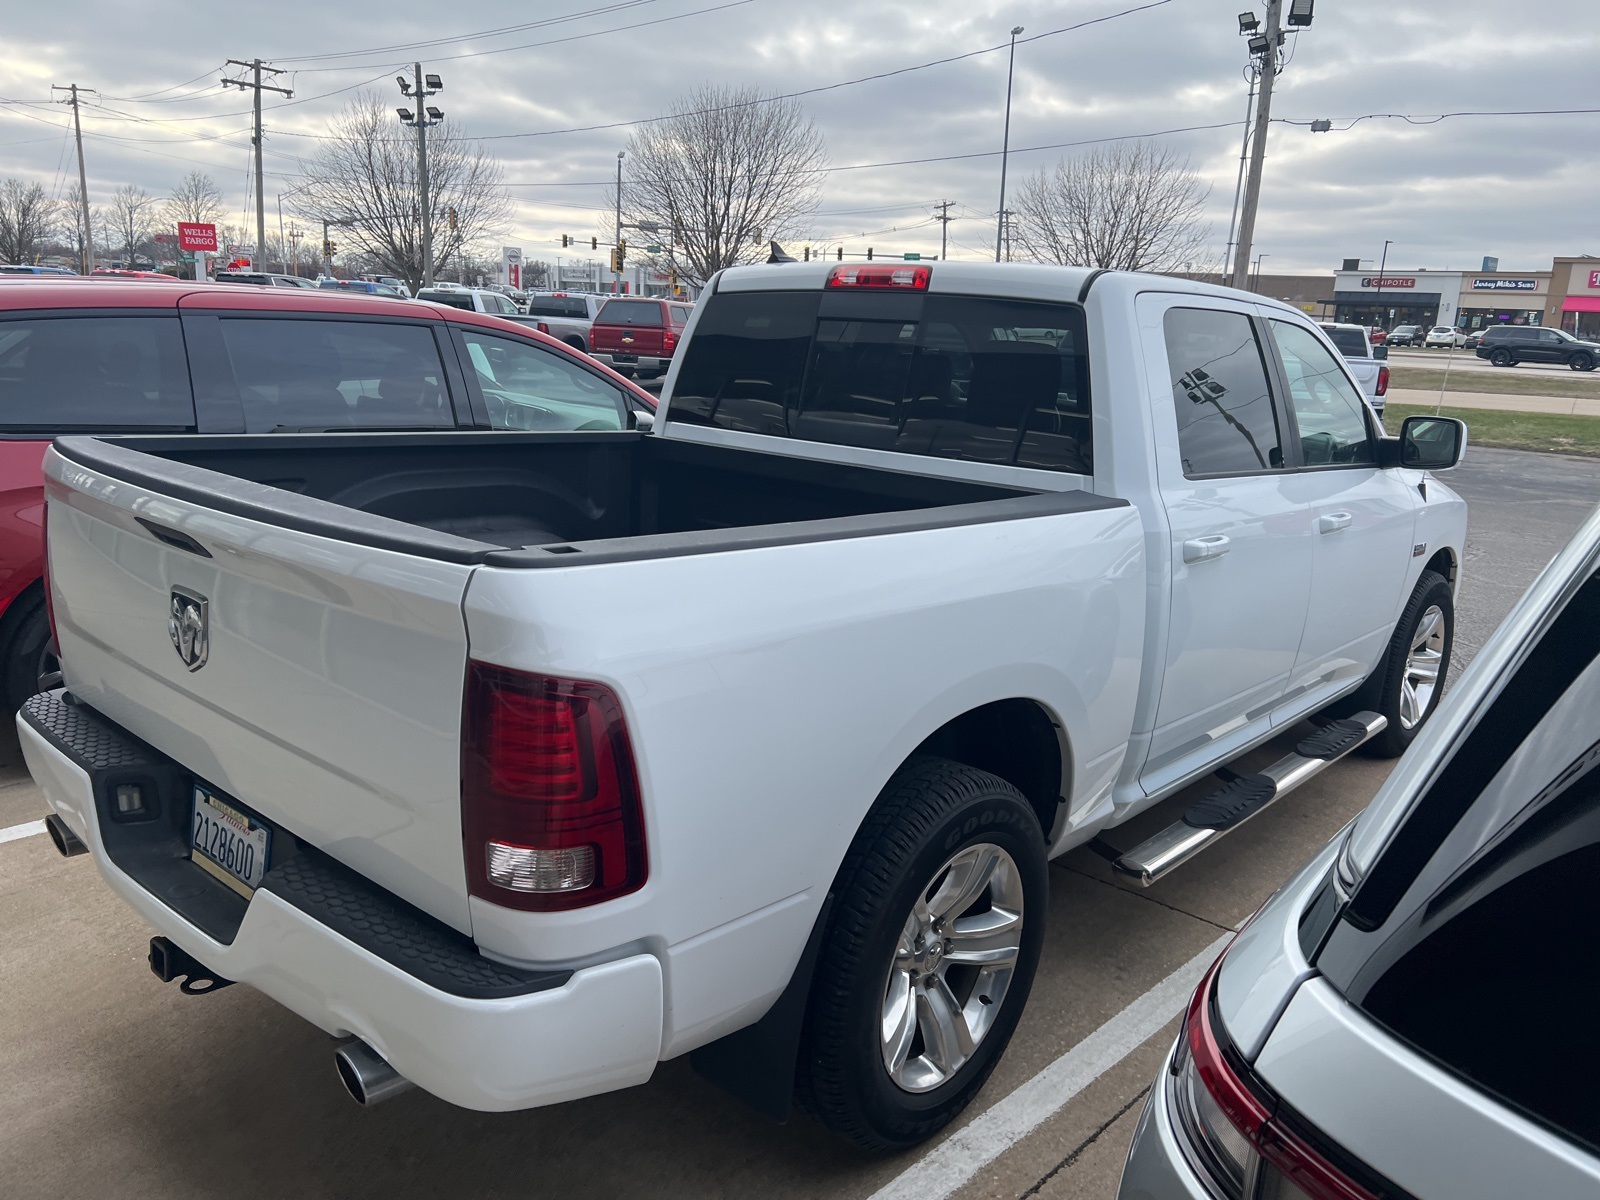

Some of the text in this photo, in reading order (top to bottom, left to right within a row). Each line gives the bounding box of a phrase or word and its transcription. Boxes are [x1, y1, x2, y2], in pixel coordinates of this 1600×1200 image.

[184, 228, 213, 236] WELLS
[185, 237, 214, 245] FARGO
[1474, 280, 1496, 289] Jersey
[195, 811, 254, 880] 2128600
